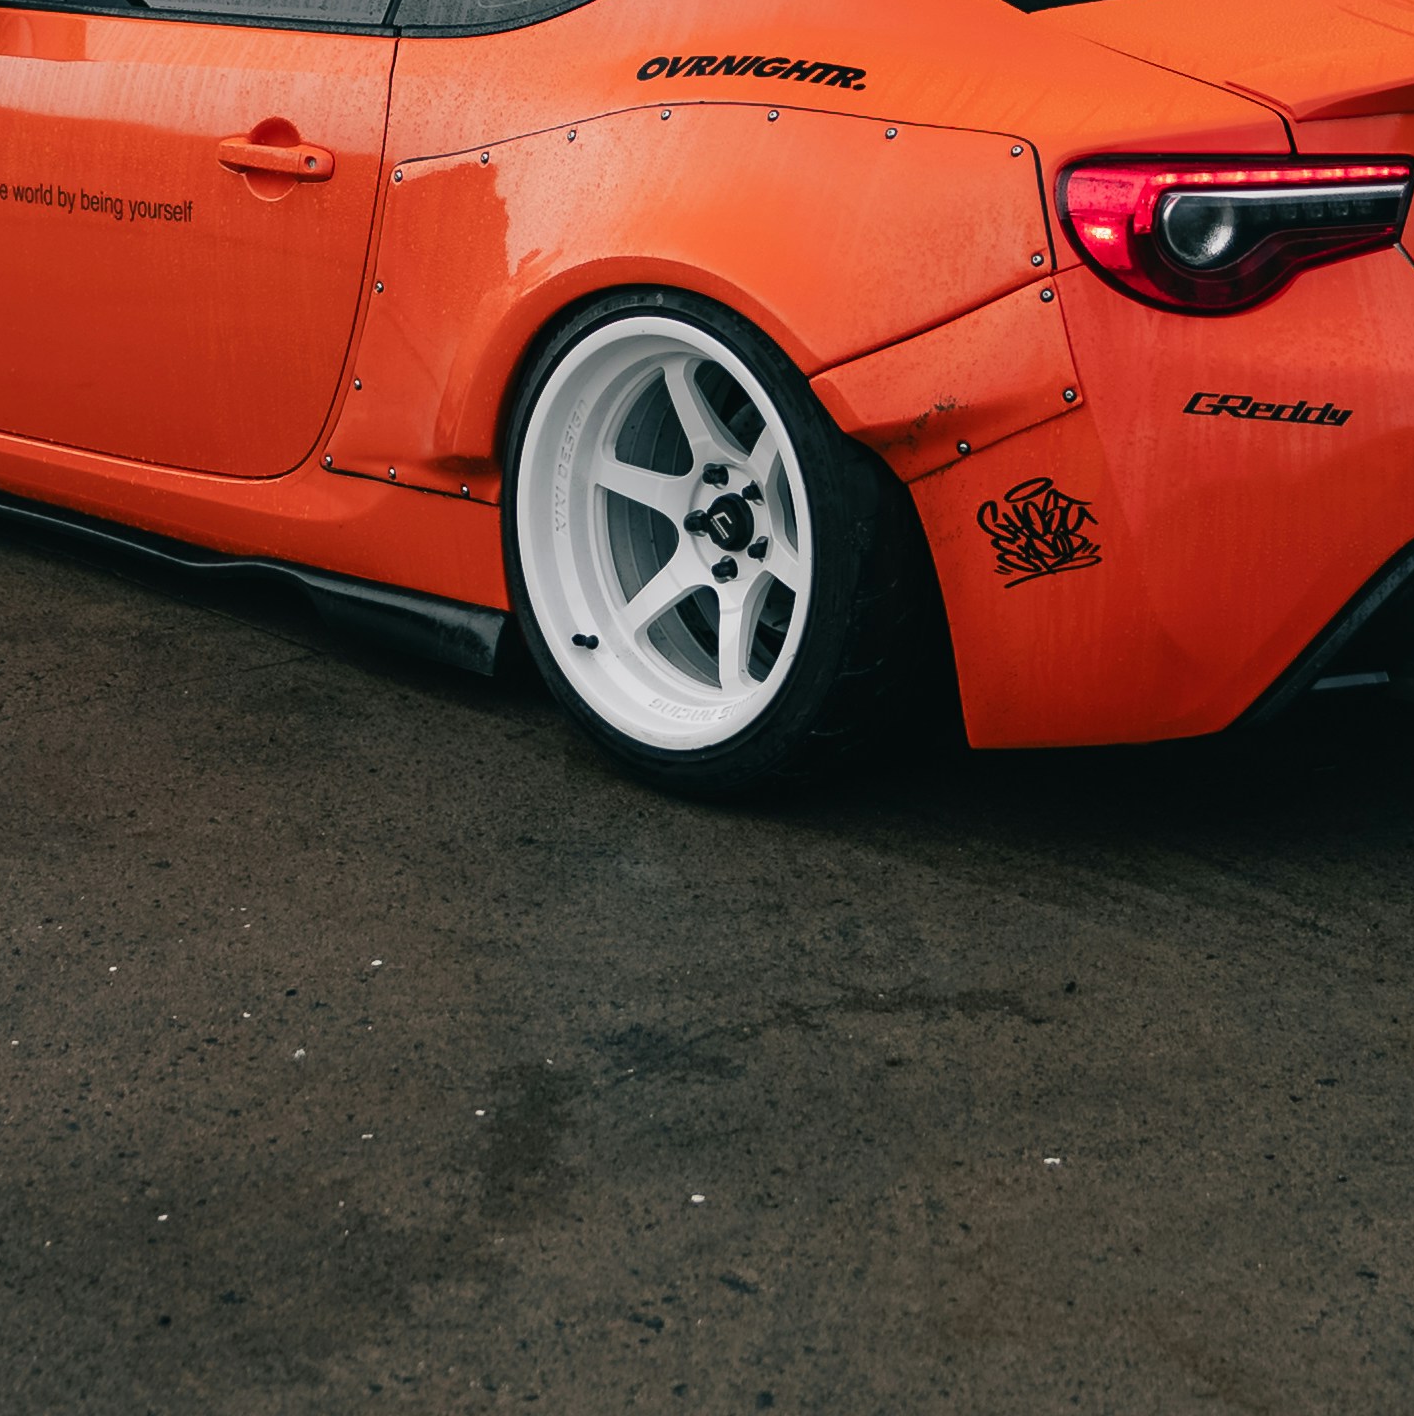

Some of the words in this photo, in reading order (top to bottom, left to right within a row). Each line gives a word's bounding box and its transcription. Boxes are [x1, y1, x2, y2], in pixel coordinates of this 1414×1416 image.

[13, 182, 53, 206] world
[57, 185, 76, 214] by
[80, 191, 124, 221] being
[128, 199, 194, 223] yourself
[1182, 391, 1354, 427] GReddy
